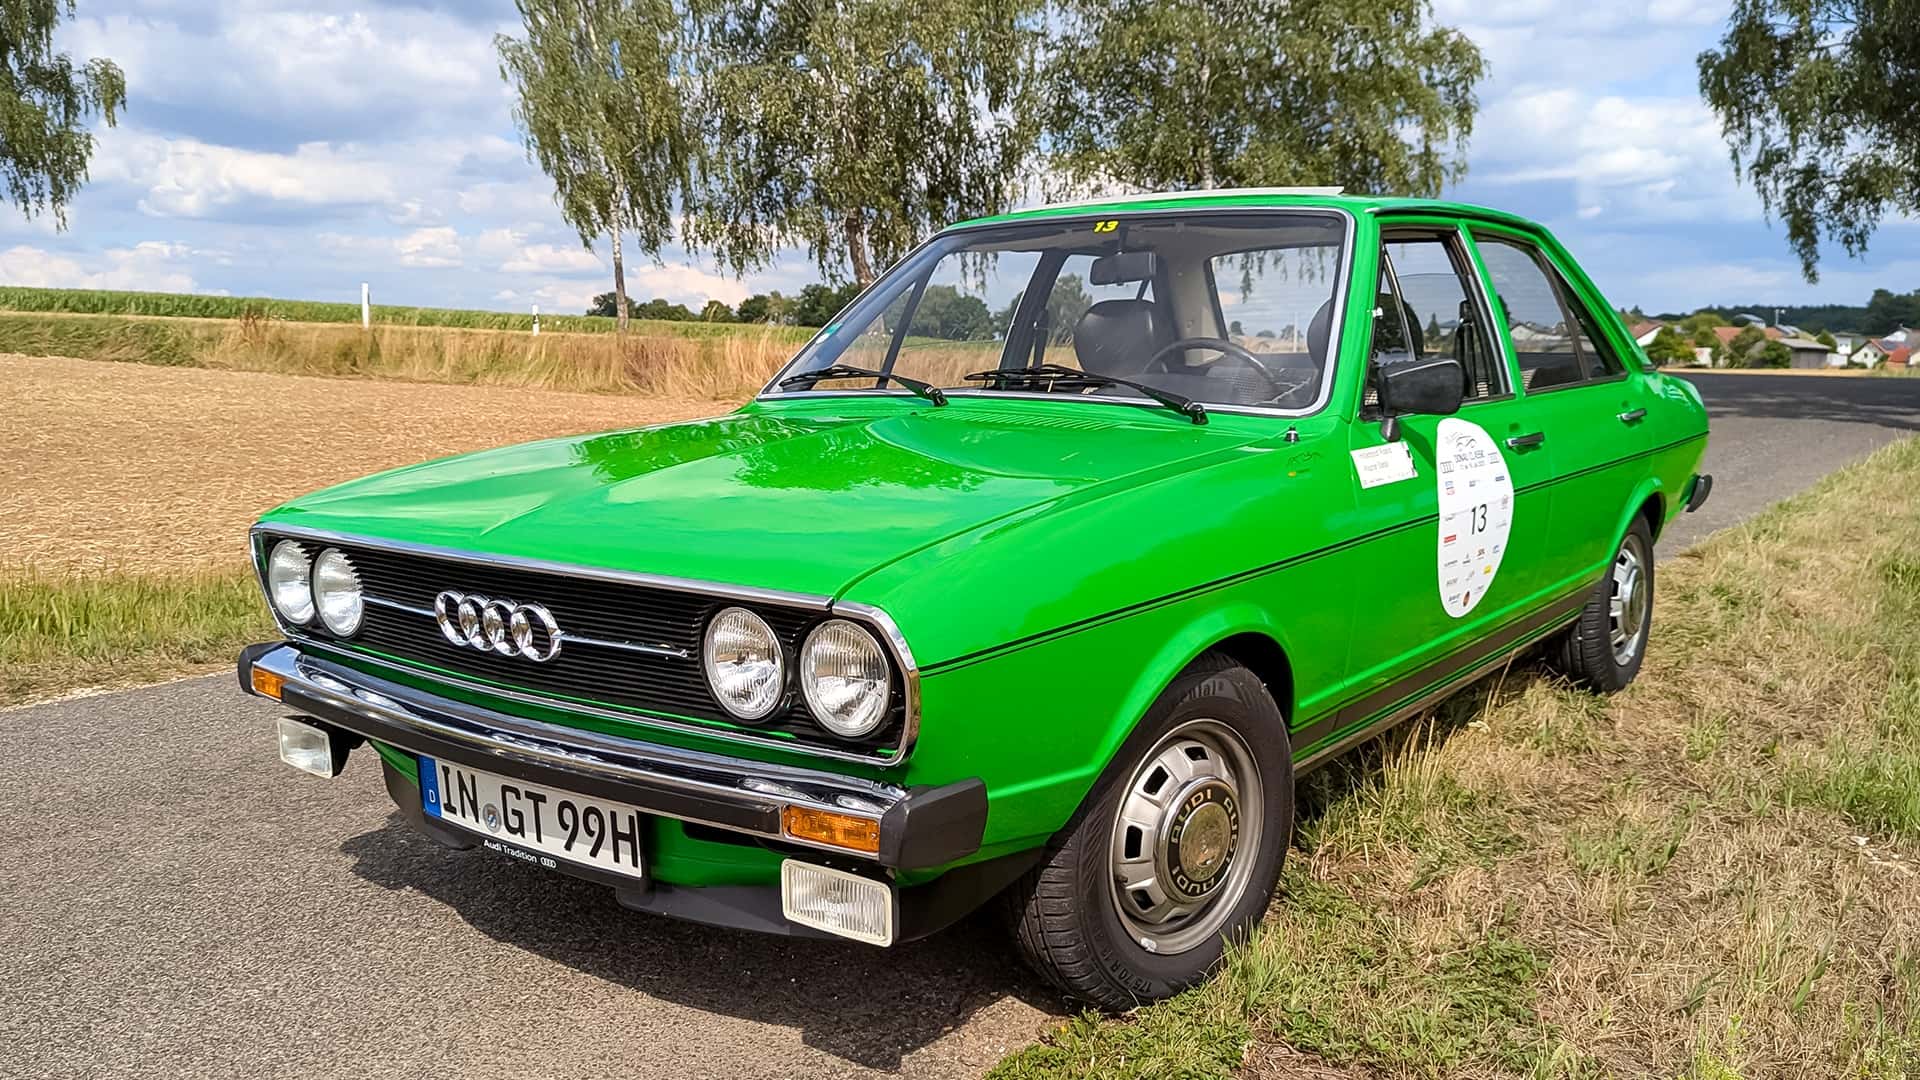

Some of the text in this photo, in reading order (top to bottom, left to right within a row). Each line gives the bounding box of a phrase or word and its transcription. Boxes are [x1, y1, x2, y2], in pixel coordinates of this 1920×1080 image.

[1093, 220, 1119, 233] 13
[1470, 503, 1487, 536] 13
[429, 789, 436, 803] D
[441, 765, 639, 868] IN GT 99H
[1170, 788, 1212, 844] AUDI
[1223, 796, 1238, 863] AUDI
[483, 839, 537, 863] Audi Tradition
[1171, 865, 1215, 897] AUDI
